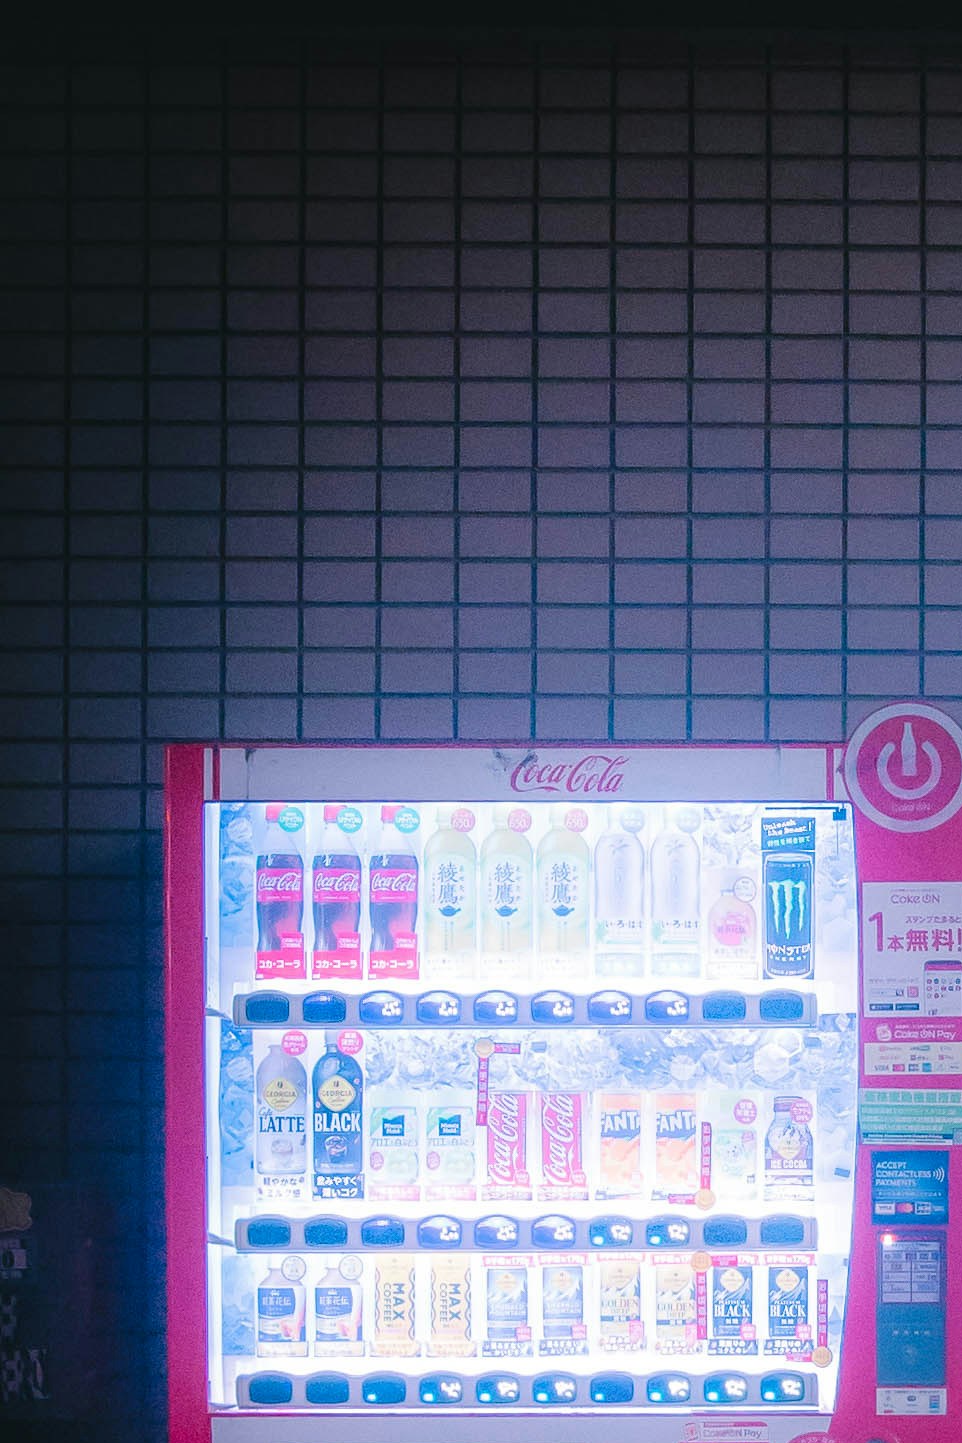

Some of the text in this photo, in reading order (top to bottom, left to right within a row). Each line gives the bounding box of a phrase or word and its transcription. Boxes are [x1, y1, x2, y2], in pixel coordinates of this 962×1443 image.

[437, 862, 459, 904] 綾鷹
[494, 862, 516, 904] 綾鷹
[551, 862, 571, 904] 綾鷹
[890, 894, 920, 904] Coke
[937, 1030, 957, 1040] Pay
[259, 1116, 305, 1133] LATTE
[315, 1112, 360, 1132] BLACK
[876, 1161, 907, 1169] ACCEPT
[876, 1170, 931, 1178] CONTACTLESS
[876, 1178, 917, 1186] PAYMENTS
[384, 1283, 392, 1322] COFFEE
[393, 1283, 405, 1321] MAX
[449, 1283, 461, 1321] MAX
[714, 1304, 751, 1317] BLACK
[770, 1304, 806, 1317] BLACK
[744, 1429, 762, 1439] Pay
